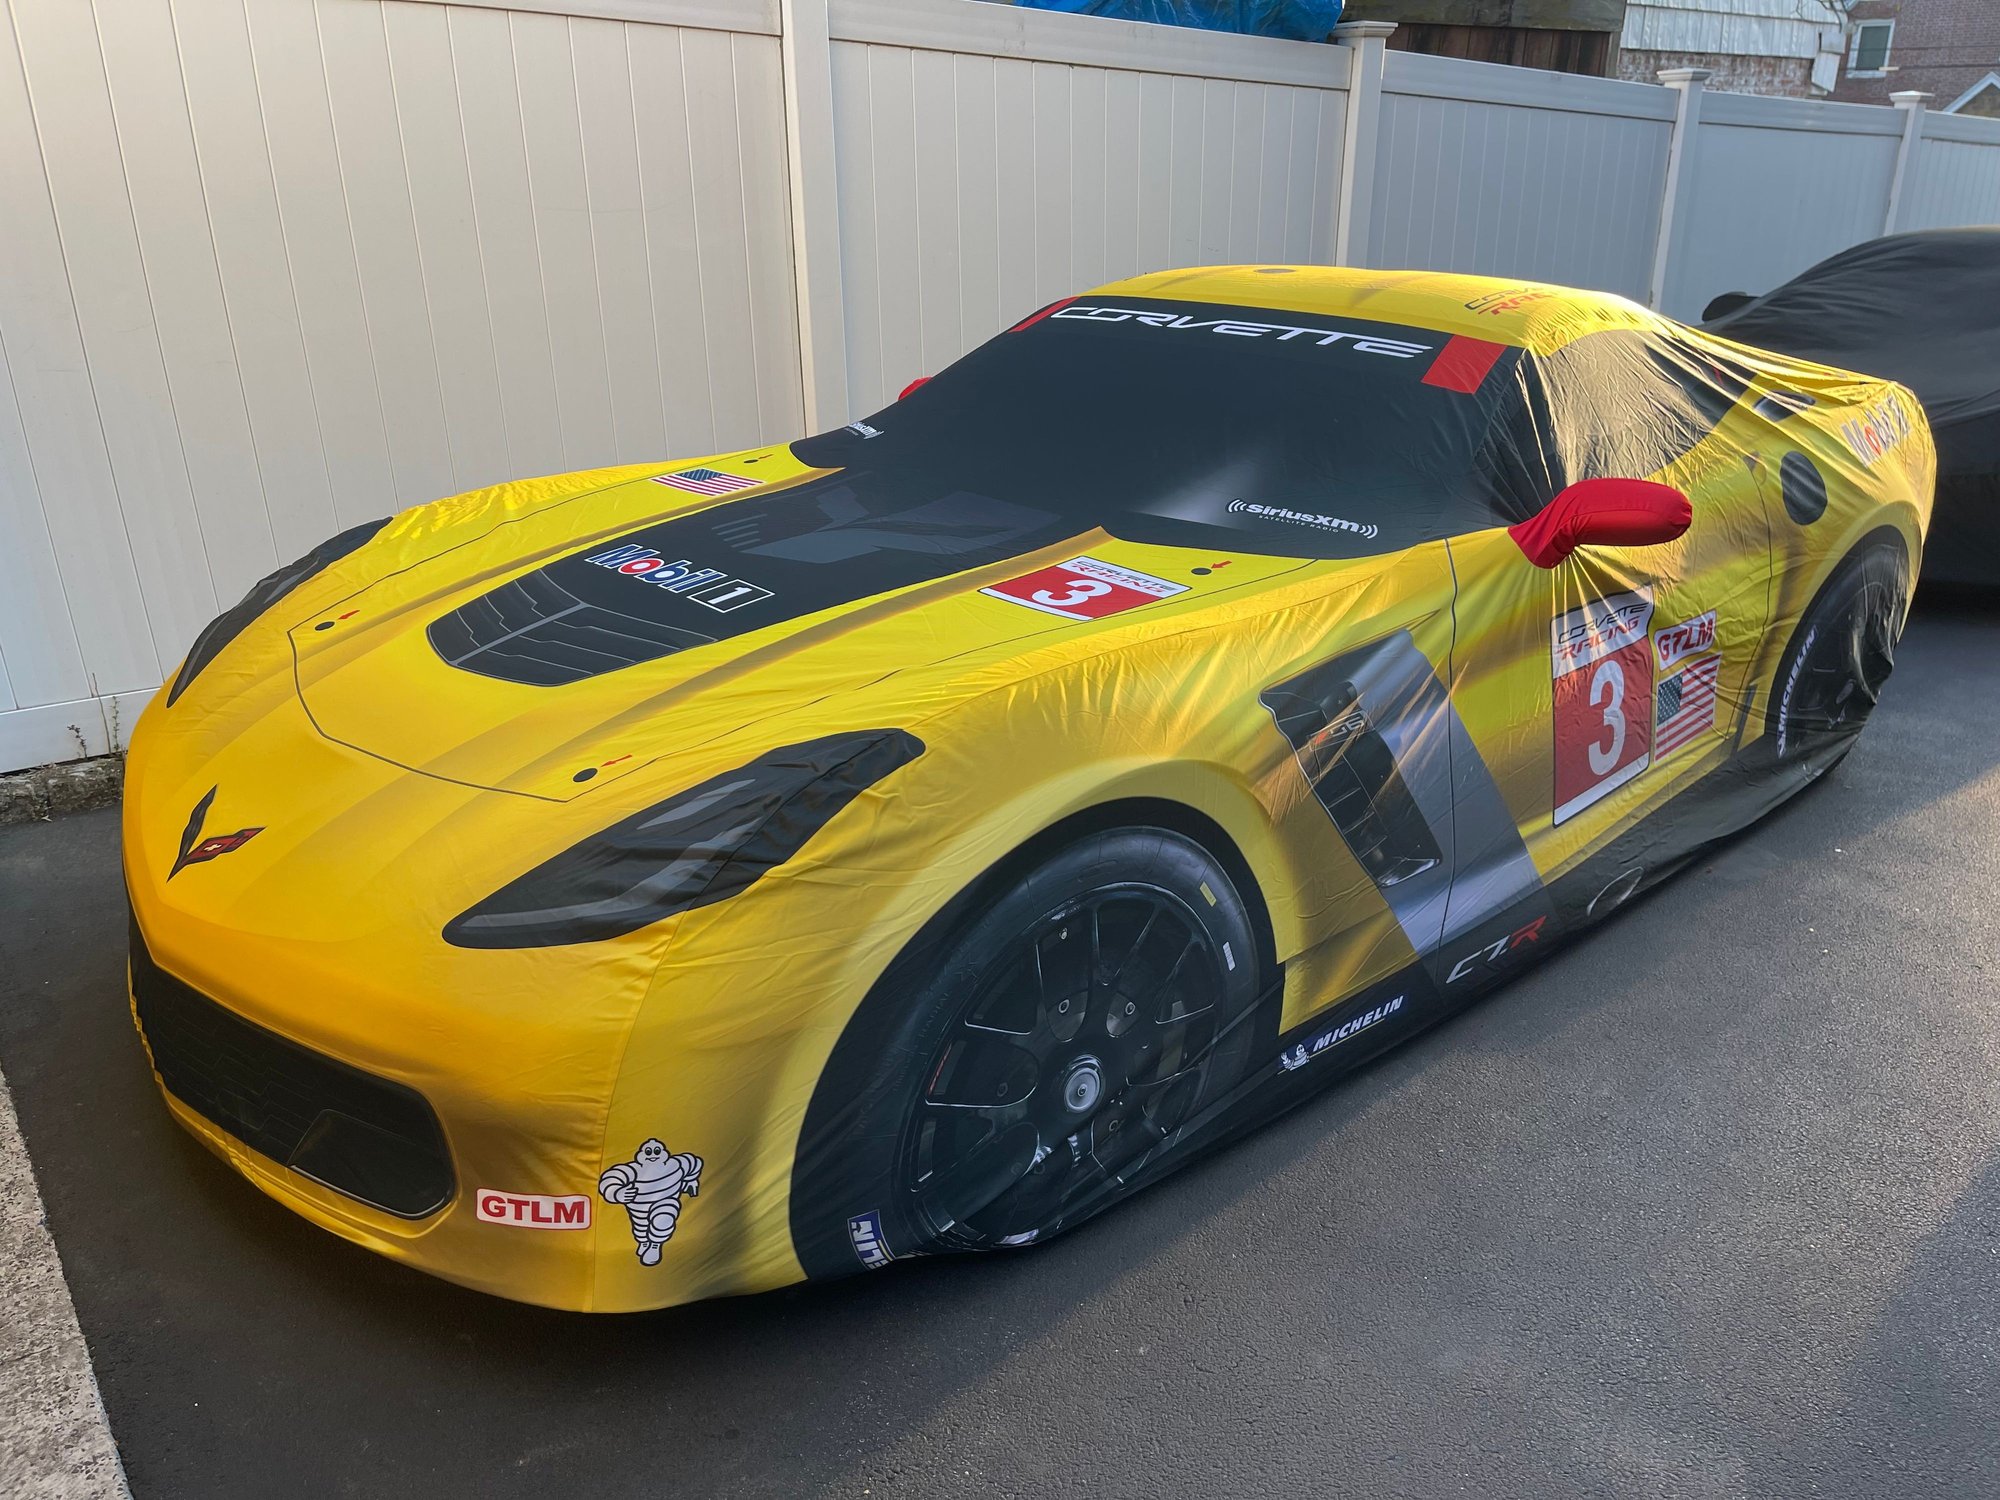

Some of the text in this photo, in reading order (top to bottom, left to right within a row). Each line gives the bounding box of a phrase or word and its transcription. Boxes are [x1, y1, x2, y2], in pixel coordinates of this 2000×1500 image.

[1051, 307, 1433, 358] CORVETTE
[1259, 515, 1339, 533] SATELLITE RADIO
[584, 544, 728, 593] Mobil
[1071, 562, 1165, 592] RACING
[1077, 561, 1178, 591] CORVETTE
[1032, 580, 1112, 606] 3
[1556, 616, 1640, 660] RACING
[1558, 603, 1650, 644] CORVETTE
[1657, 619, 1713, 661] GTLM
[1778, 627, 1817, 732] MICHELIN
[1588, 660, 1626, 776] 3
[1313, 996, 1403, 1052] MICHELIN
[482, 1196, 584, 1223] GTLM
